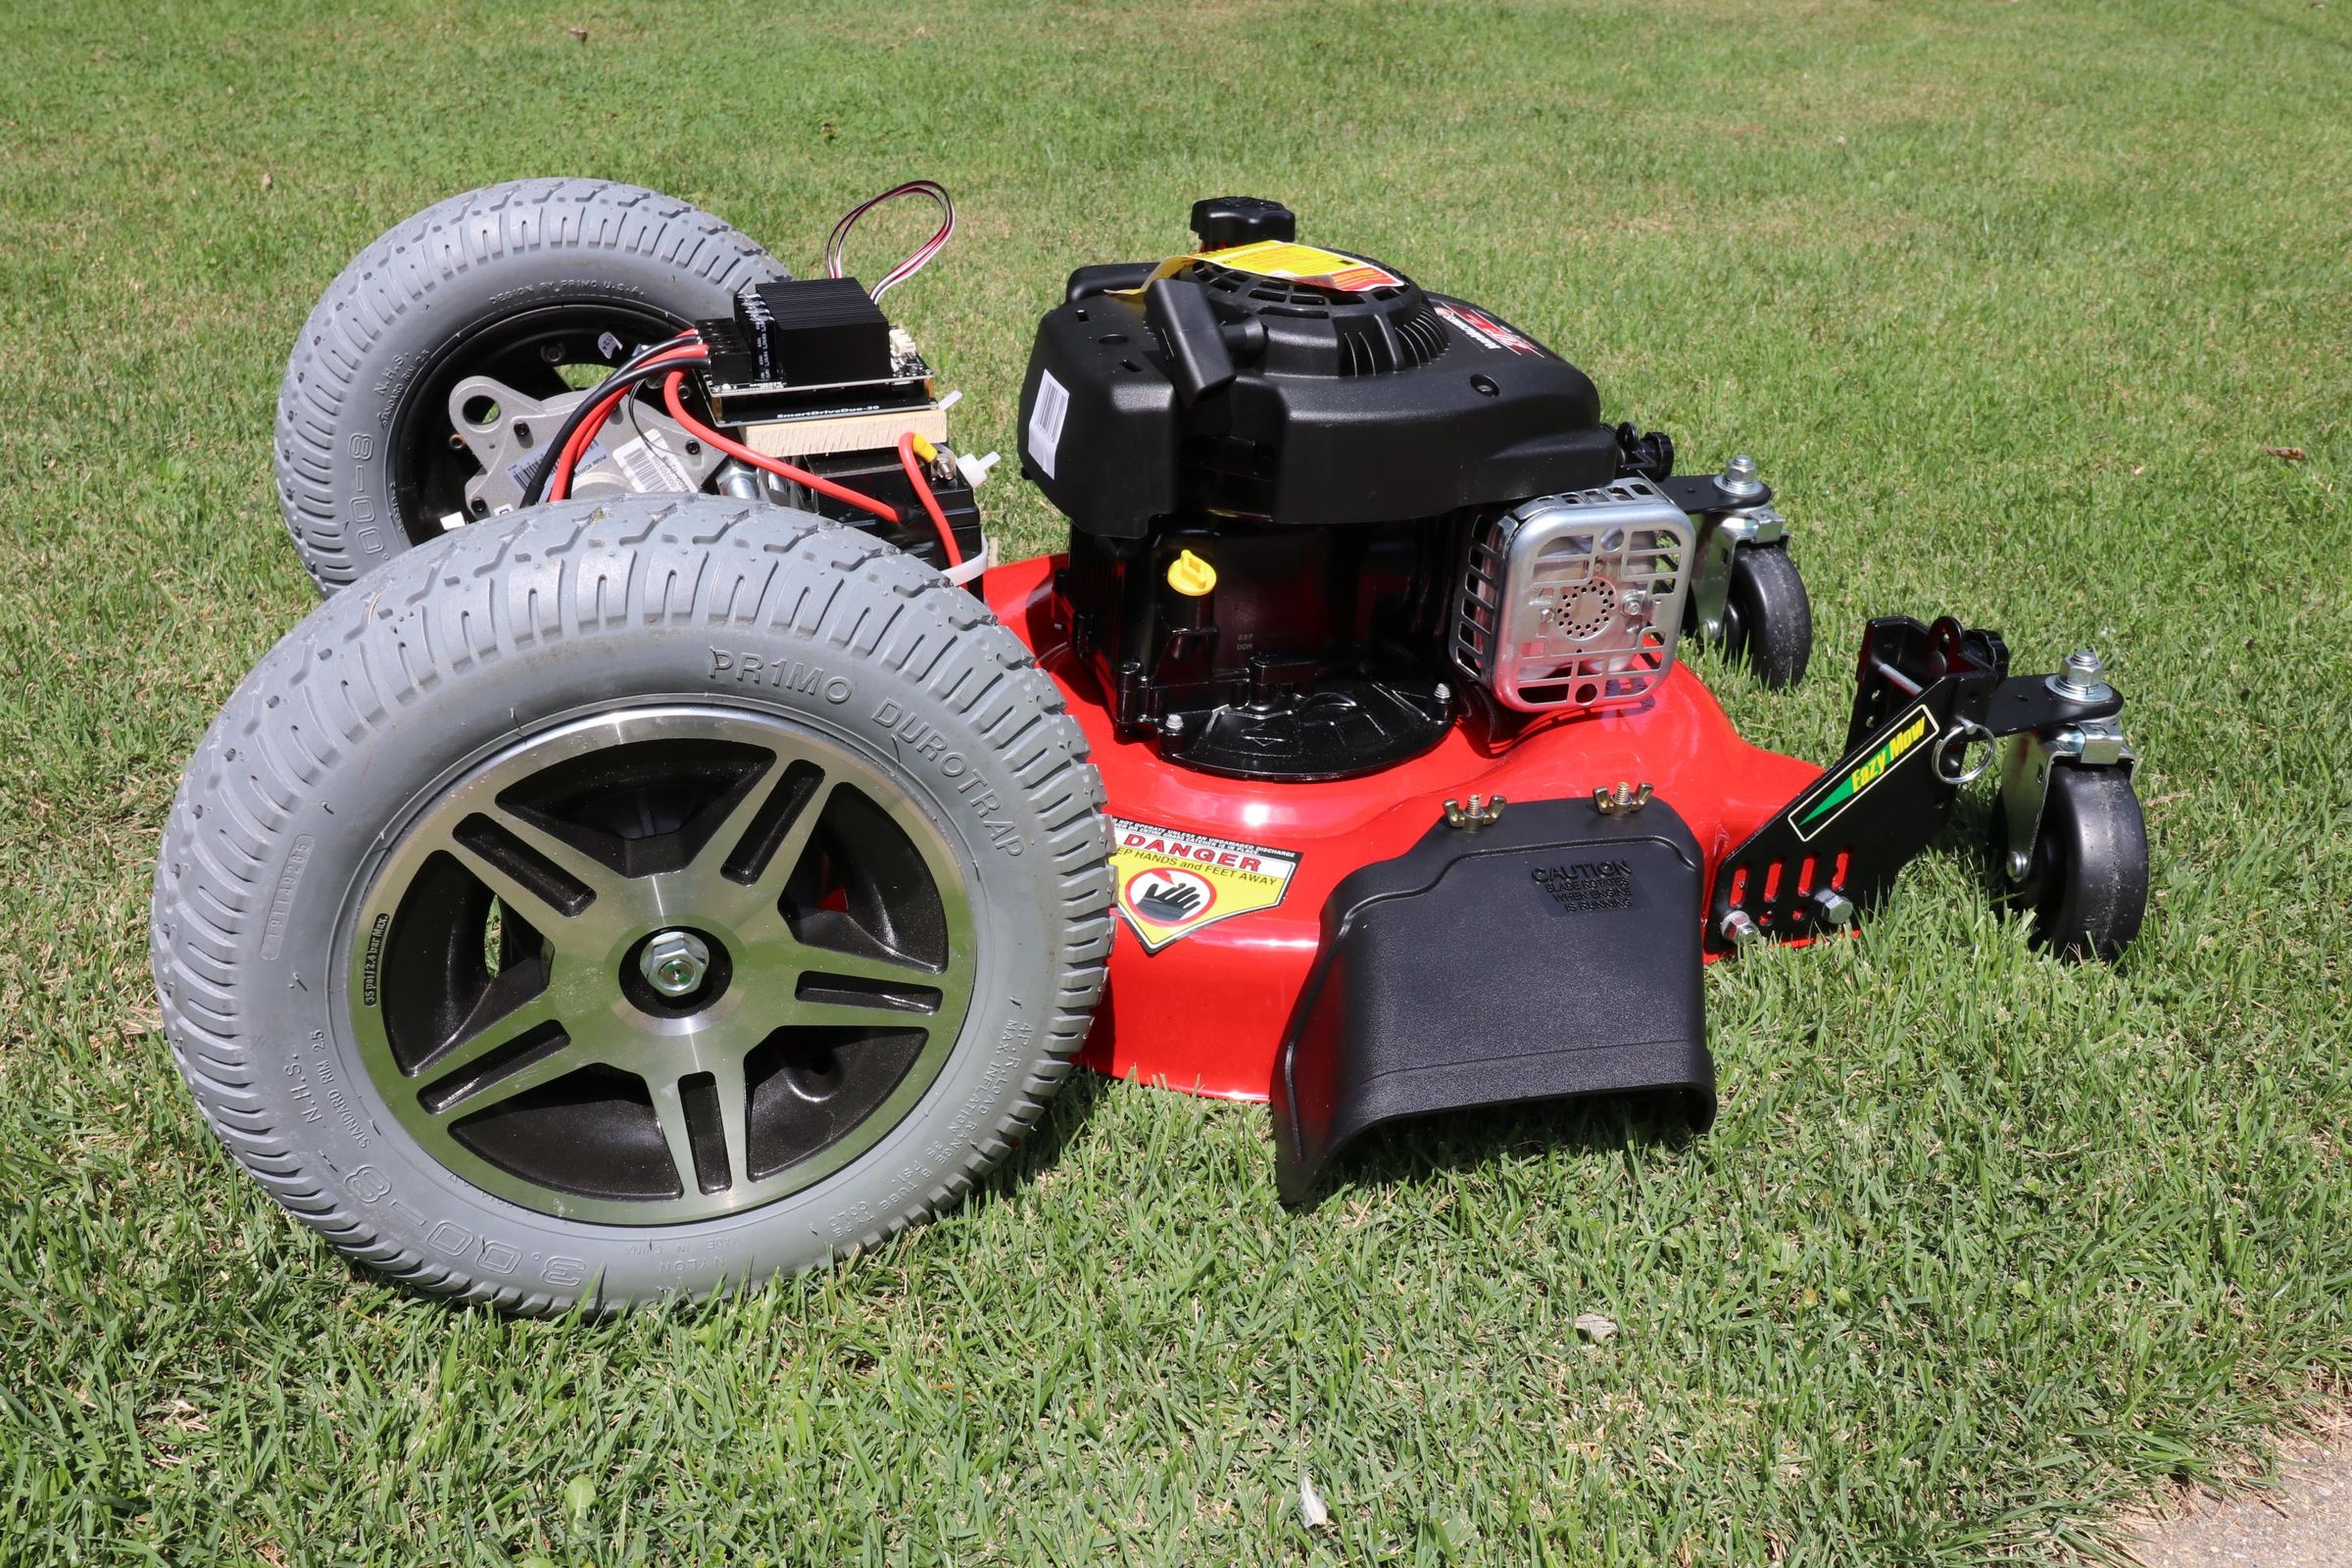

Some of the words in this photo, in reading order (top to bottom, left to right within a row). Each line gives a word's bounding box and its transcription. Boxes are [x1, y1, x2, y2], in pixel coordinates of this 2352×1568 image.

[489, 284, 534, 305] DESIGN
[373, 353, 410, 396] N.H.S.
[776, 405, 880, 418] SmartDriveDuo-30
[1850, 749, 1886, 794] Eazy
[1888, 715, 1927, 762] Mow
[870, 696, 1026, 858] DUROTRAP
[1123, 833, 1262, 872] DANGER
[1135, 822, 1166, 833] OPERATE
[1167, 829, 1196, 839] UNLESS
[1208, 837, 1254, 850] UNDAMAGED
[1255, 846, 1297, 858] DISCHARGE
[1116, 846, 1133, 856] EP
[1134, 850, 1181, 866] HANDS
[1179, 860, 1203, 872] and
[1203, 864, 1239, 878] FEET
[1238, 871, 1279, 887] AWAY
[1531, 860, 1632, 884] CAUTION
[1544, 881, 1583, 893] BLADE
[1552, 891, 1589, 903] WHEN
[1589, 886, 1633, 900] ENGINE
[372, 914, 389, 938] Max.
[368, 937, 380, 954] bar
[996, 1018, 1019, 1055] MAX.
[284, 1053, 323, 1124] N.H.S.
[315, 1059, 335, 1085] RIM
[948, 1059, 1002, 1136] INFLATION
[978, 1077, 1008, 1115] LOAD
[327, 1089, 371, 1149] STANDARD
[934, 1120, 978, 1165] RANGE
[878, 1180, 919, 1212] TUBE
[344, 1163, 587, 1288] 3.00-8
[659, 1254, 726, 1275] NYLON
